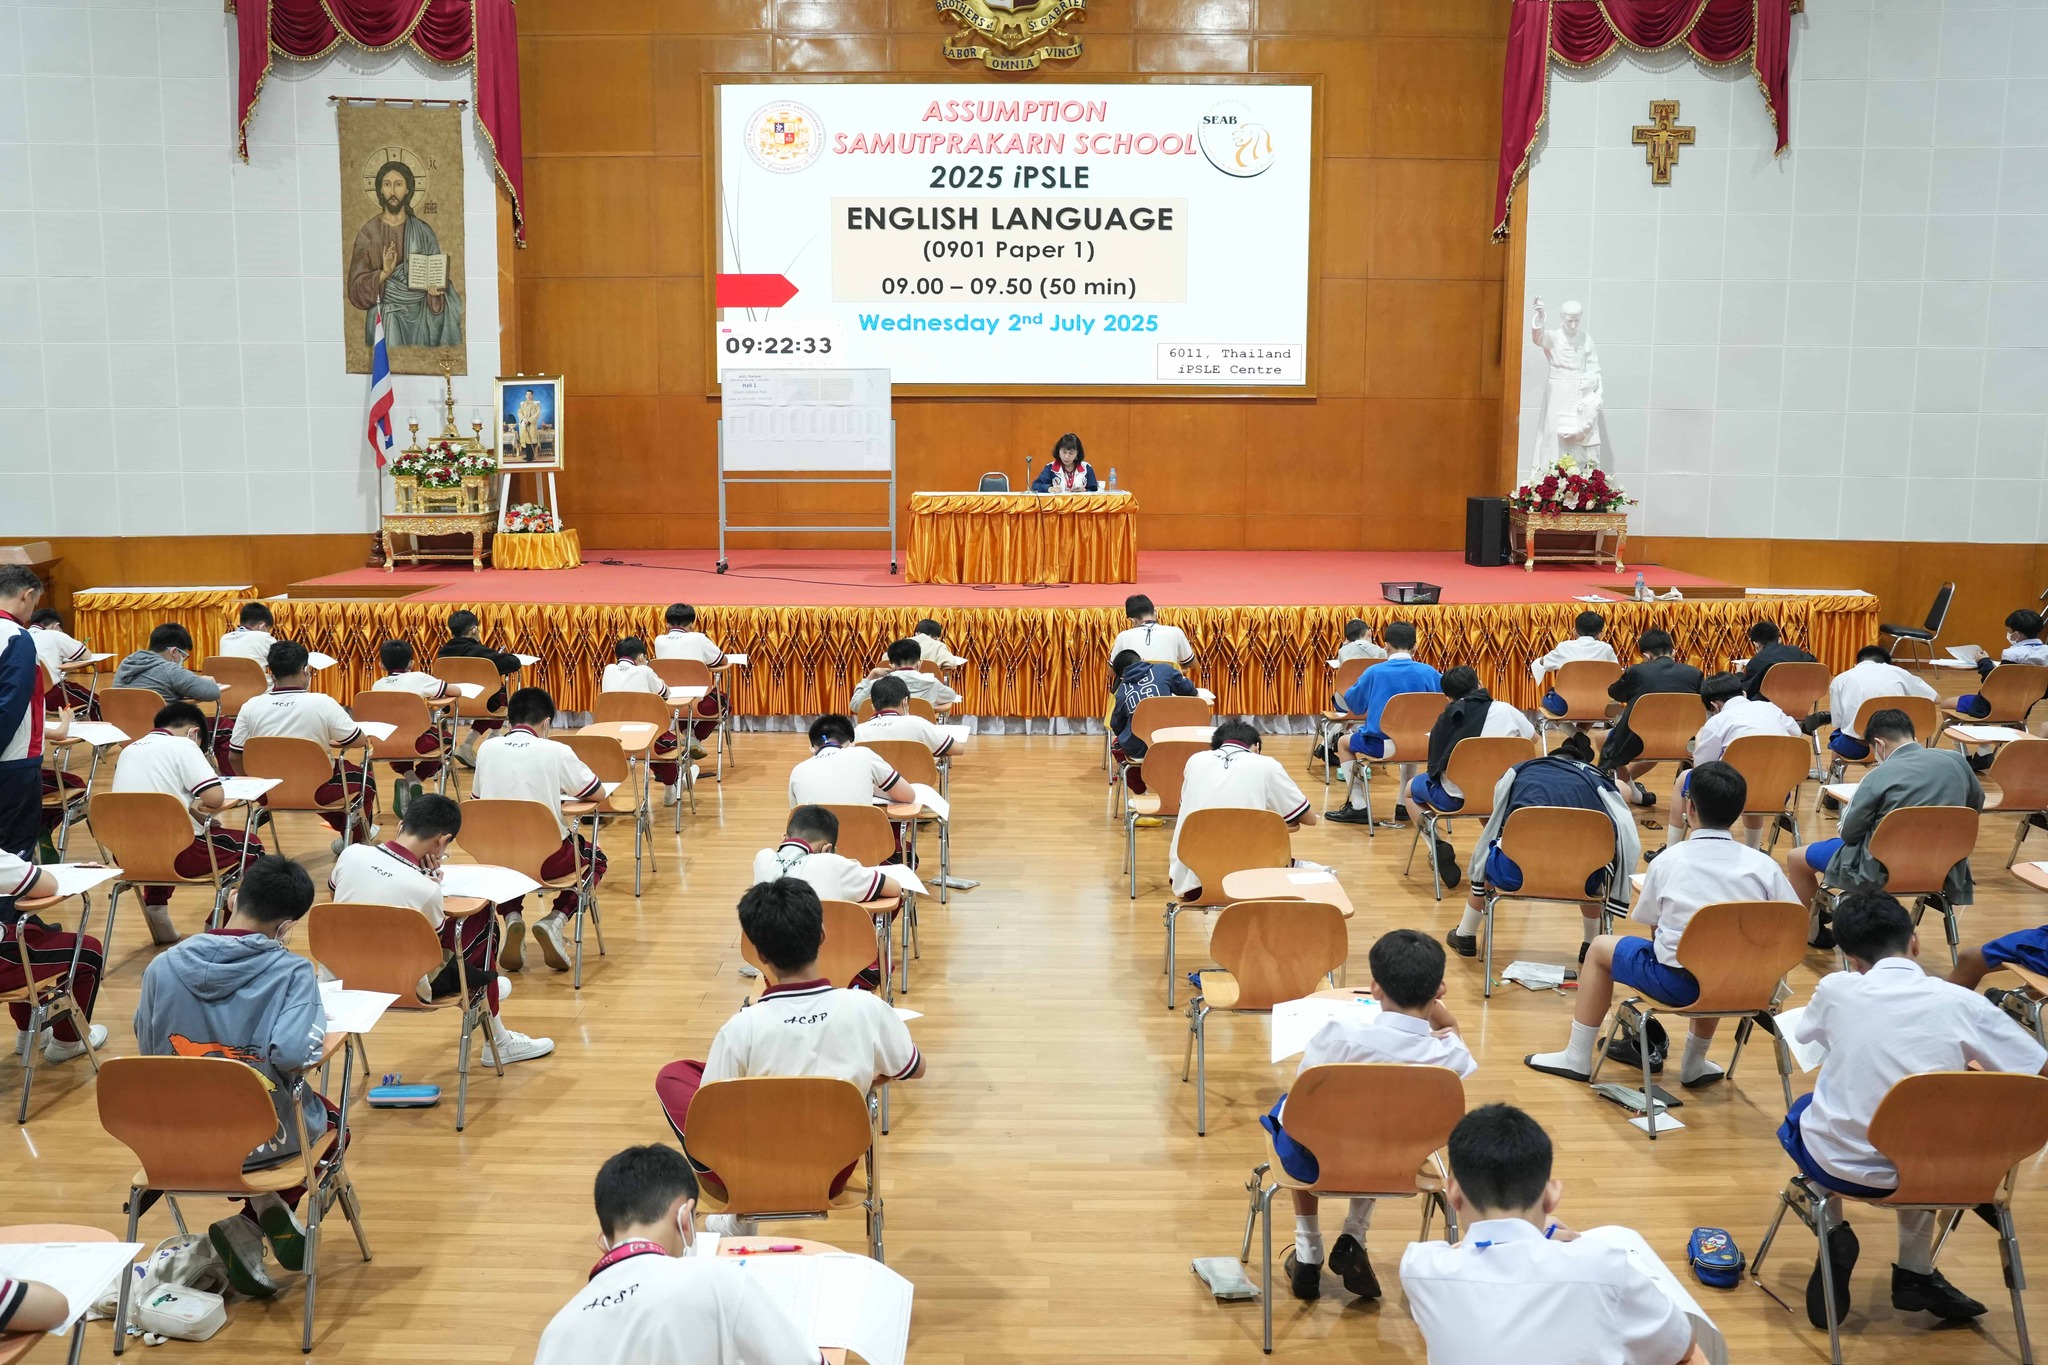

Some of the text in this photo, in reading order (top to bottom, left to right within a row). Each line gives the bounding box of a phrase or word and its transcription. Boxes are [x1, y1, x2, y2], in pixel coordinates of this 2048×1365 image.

[936, 0, 985, 27] BROTHERS
[942, 44, 1083, 70] LABOR OMNIA VINCIT
[922, 100, 1107, 122] ASSUMPTION
[1202, 115, 1238, 125] SEAB
[833, 132, 1065, 155] SAMUTPRAKARN
[1073, 133, 1197, 155] SCHOOL
[930, 165, 1090, 189] 2025 iPSLE
[848, 206, 1173, 231] ENGLISH LANGUAGE
[923, 240, 1095, 263] (0901 Paper 1)
[882, 277, 944, 295] 09.00
[970, 277, 1032, 295] 09.50
[1039, 277, 1076, 300] (50
[1084, 277, 1136, 300] min)
[859, 313, 1159, 335] Wednesday 2nd July 2025
[726, 337, 832, 354] 09:22:33
[1169, 348, 1291, 359] 6011, Thailand
[1178, 364, 1282, 374] iPSLE Centre
[783, 1012, 828, 1025] ACSP
[583, 1283, 639, 1311] ACSP
